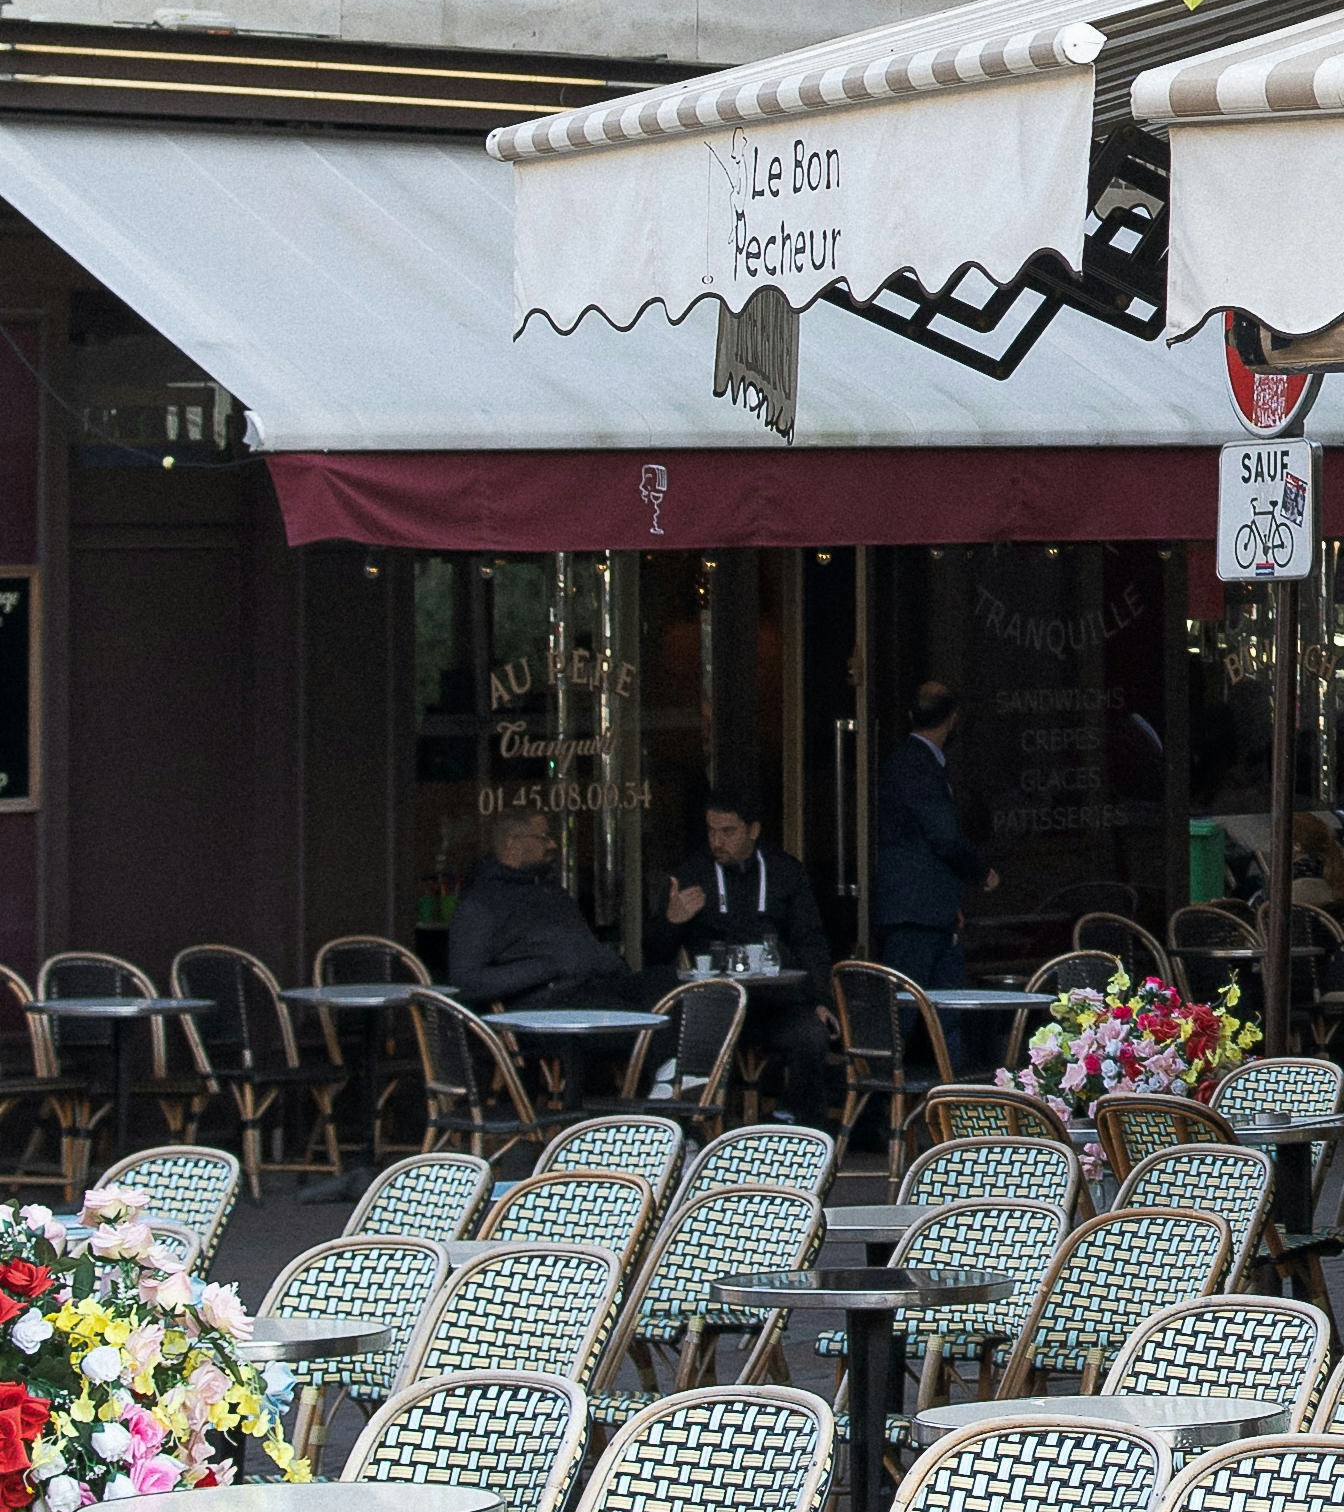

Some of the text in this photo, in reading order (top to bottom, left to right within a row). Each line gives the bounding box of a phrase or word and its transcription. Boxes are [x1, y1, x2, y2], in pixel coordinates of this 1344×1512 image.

[751, 138, 841, 201] Le Bon
[733, 208, 842, 282] Pecheur
[1240, 449, 1290, 484] SAUF
[974, 582, 1146, 660] TRANQUILLE
[489, 656, 533, 712] AU
